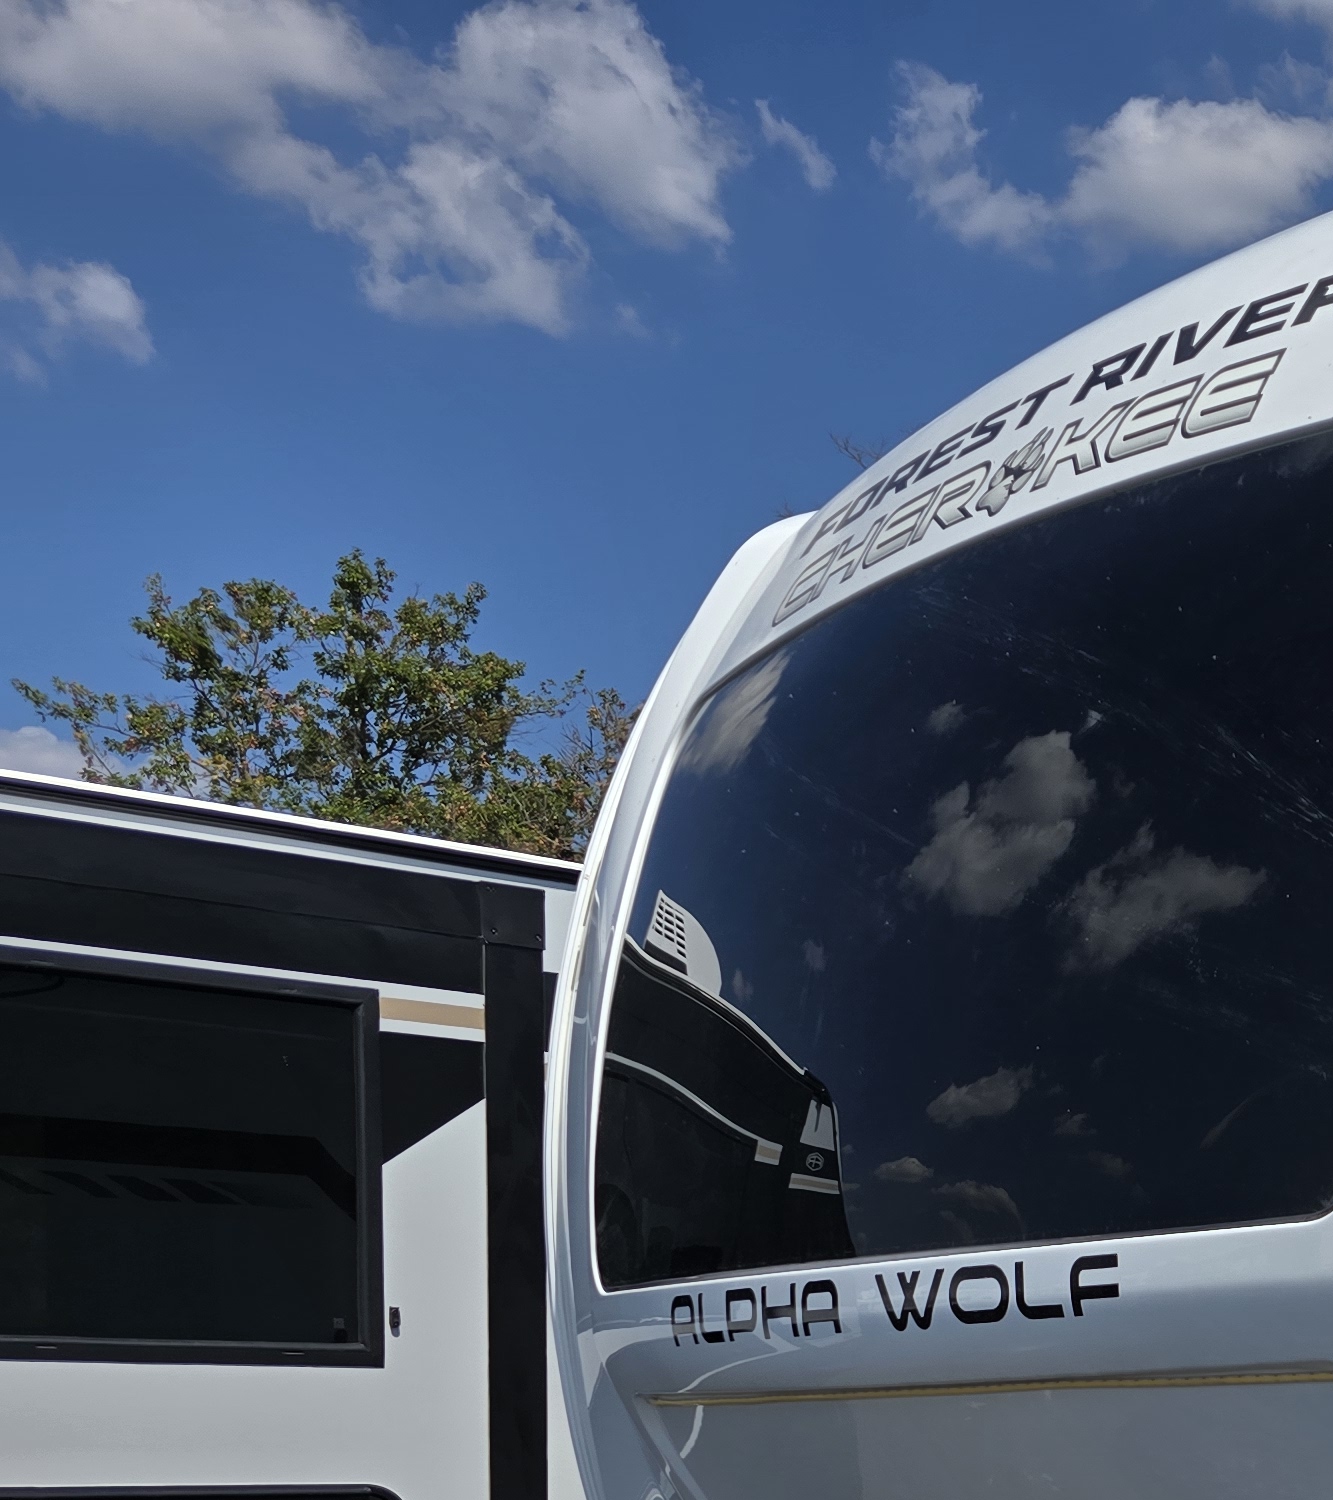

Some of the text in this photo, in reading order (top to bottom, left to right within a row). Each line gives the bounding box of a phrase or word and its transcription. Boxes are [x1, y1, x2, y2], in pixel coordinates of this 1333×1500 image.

[800, 373, 1074, 559] FOREST
[670, 1252, 1120, 1347] ALPHA WOLF
